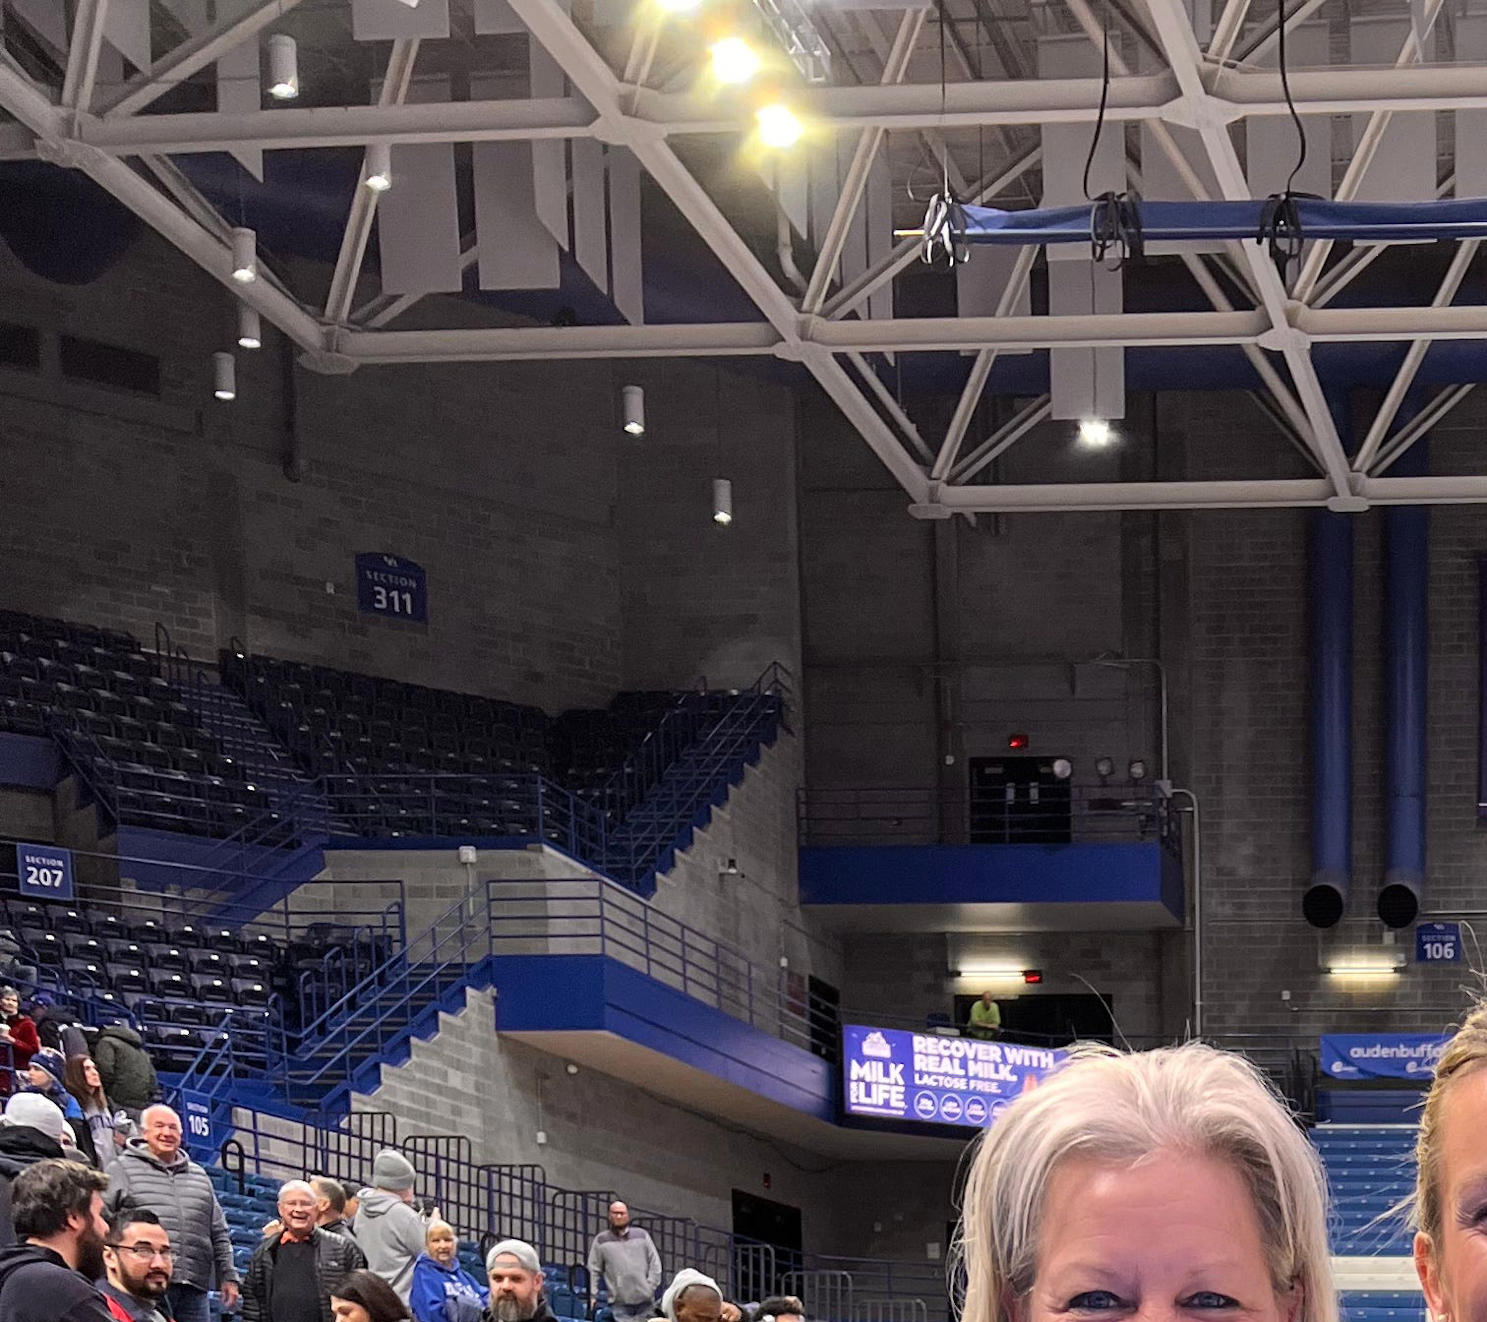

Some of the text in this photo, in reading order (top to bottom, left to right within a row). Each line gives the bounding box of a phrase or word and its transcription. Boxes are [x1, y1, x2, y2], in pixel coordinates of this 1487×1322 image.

[365, 570, 418, 589] SECTION
[373, 585, 413, 615] 311
[24, 854, 65, 868] SECTION
[26, 866, 64, 888] 207
[1423, 942, 1455, 960] 106
[913, 1035, 1055, 1069] RECOVER WITH
[1350, 1043, 1442, 1059] audenbuffa
[850, 1059, 905, 1085] MILK
[914, 1054, 1018, 1082] REAL MILK.
[915, 1073, 1002, 1093] LACTOSE FREE.
[859, 1082, 905, 1108] LIFE
[188, 1114, 210, 1137] 105
